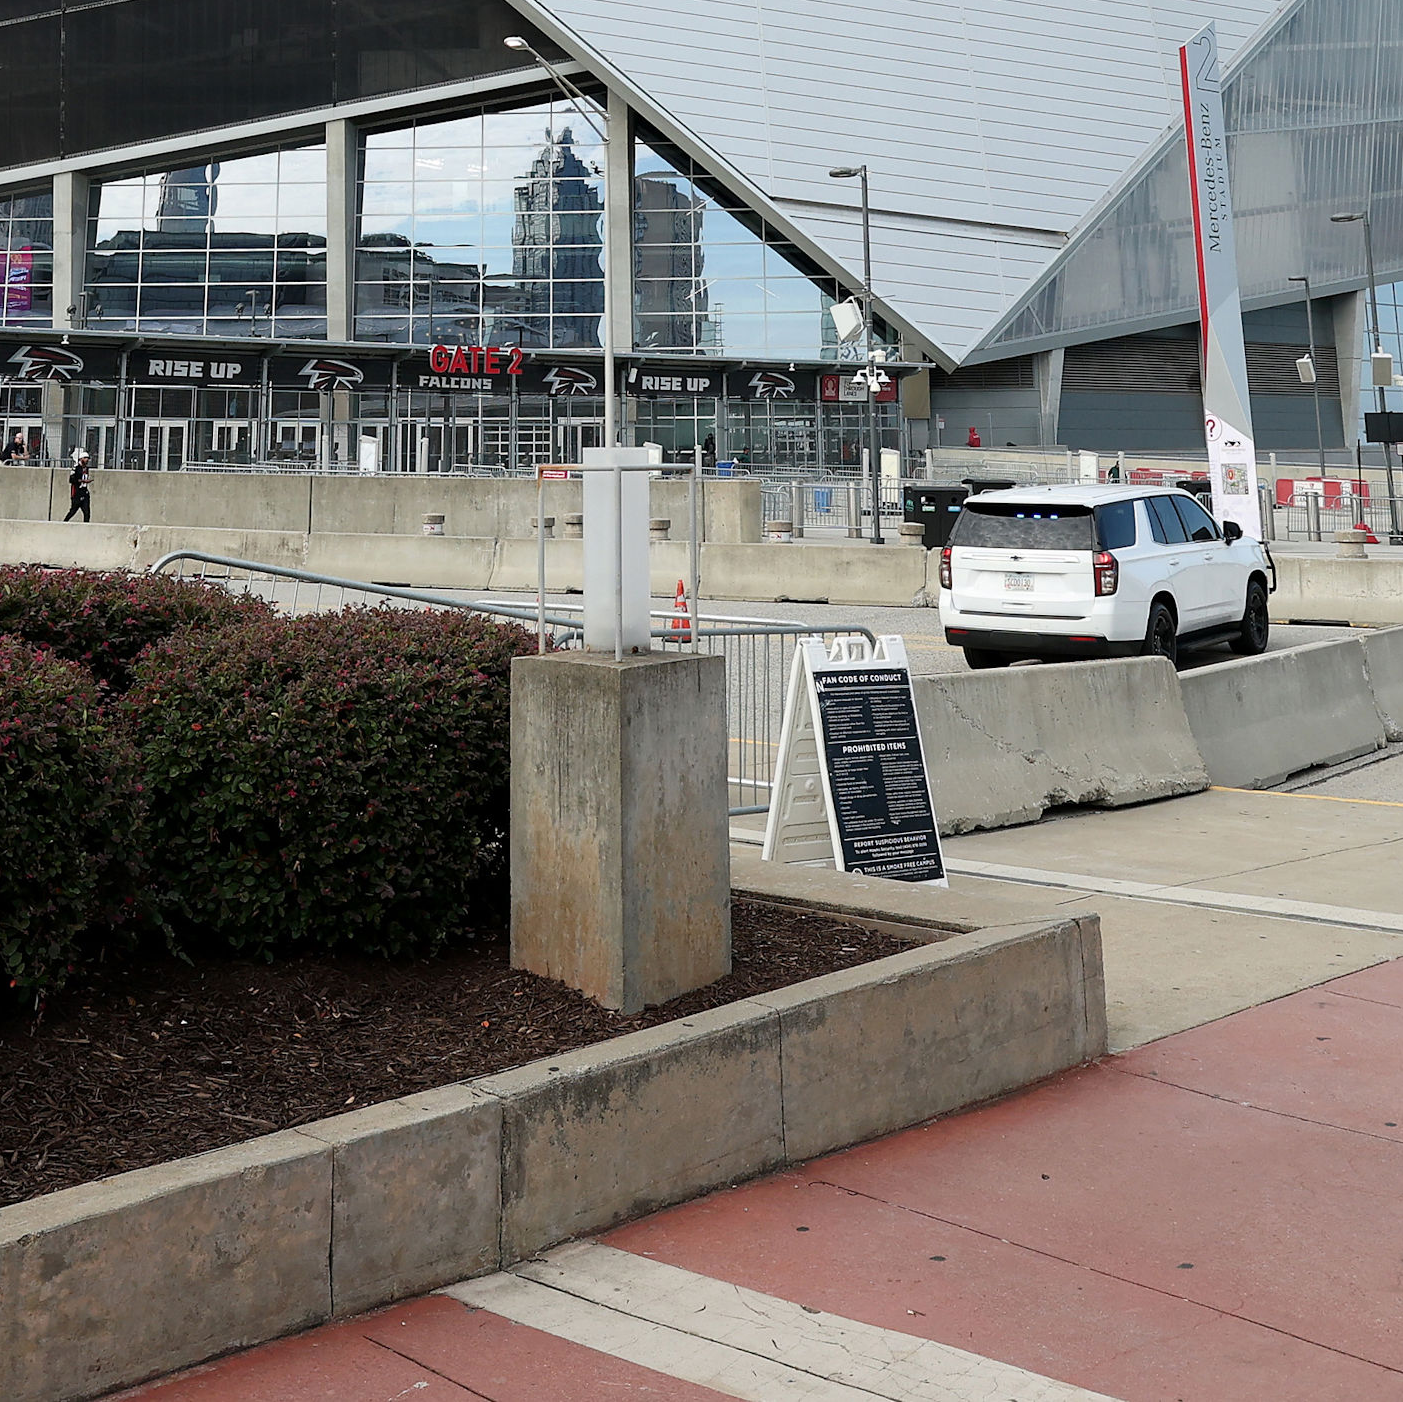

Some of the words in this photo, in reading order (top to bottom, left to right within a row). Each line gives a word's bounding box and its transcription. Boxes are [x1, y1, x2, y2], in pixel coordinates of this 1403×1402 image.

[1200, 103, 1222, 252] Mercedes-Benz
[1214, 138, 1227, 221] STADIUM
[430, 345, 500, 374] GATE
[507, 348, 523, 374] 2
[148, 359, 204, 377] RISE
[210, 362, 242, 378] UP
[419, 375, 492, 389] FALCONS
[641, 376, 682, 391] RISE
[686, 377, 710, 392] UP
[821, 676, 837, 684] FAN
[838, 675, 858, 683] CODE
[859, 674, 869, 682] OF
[870, 673, 902, 682] CONDUCT
[842, 744, 886, 754] PROHIBITED
[887, 742, 906, 750] ITEMS
